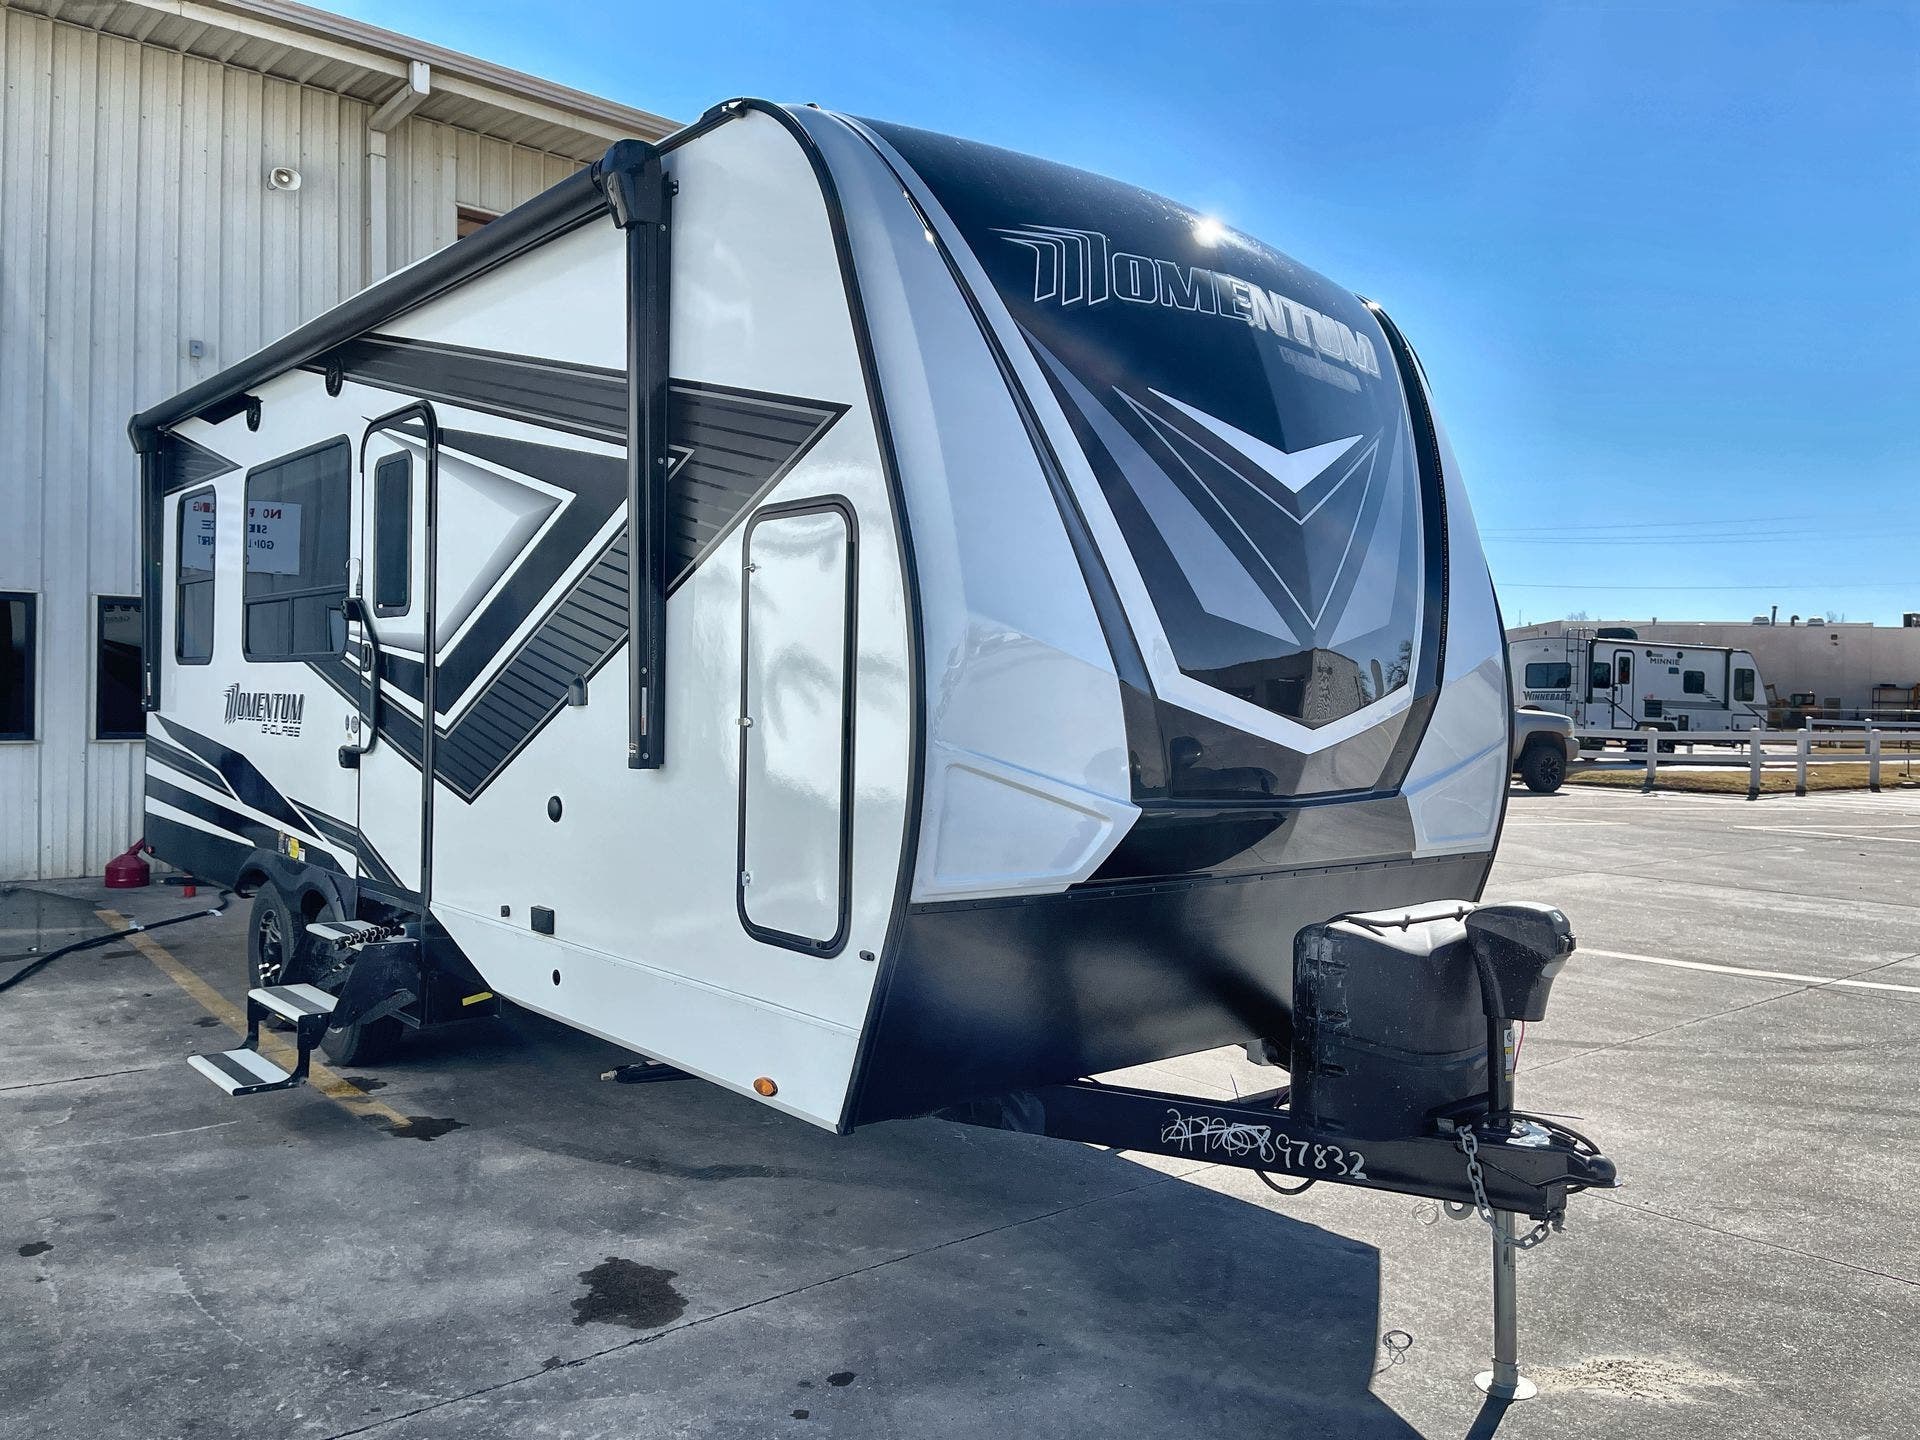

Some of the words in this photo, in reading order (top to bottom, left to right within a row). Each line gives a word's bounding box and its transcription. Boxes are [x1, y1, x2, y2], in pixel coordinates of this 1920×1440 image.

[989, 224, 1382, 379] MOMENTUM
[1650, 657, 1680, 665] MINNIE
[224, 682, 305, 724] MOMENTUM
[1523, 691, 1571, 701] WINNEBAGO
[261, 723, 301, 737] G-CLASS
